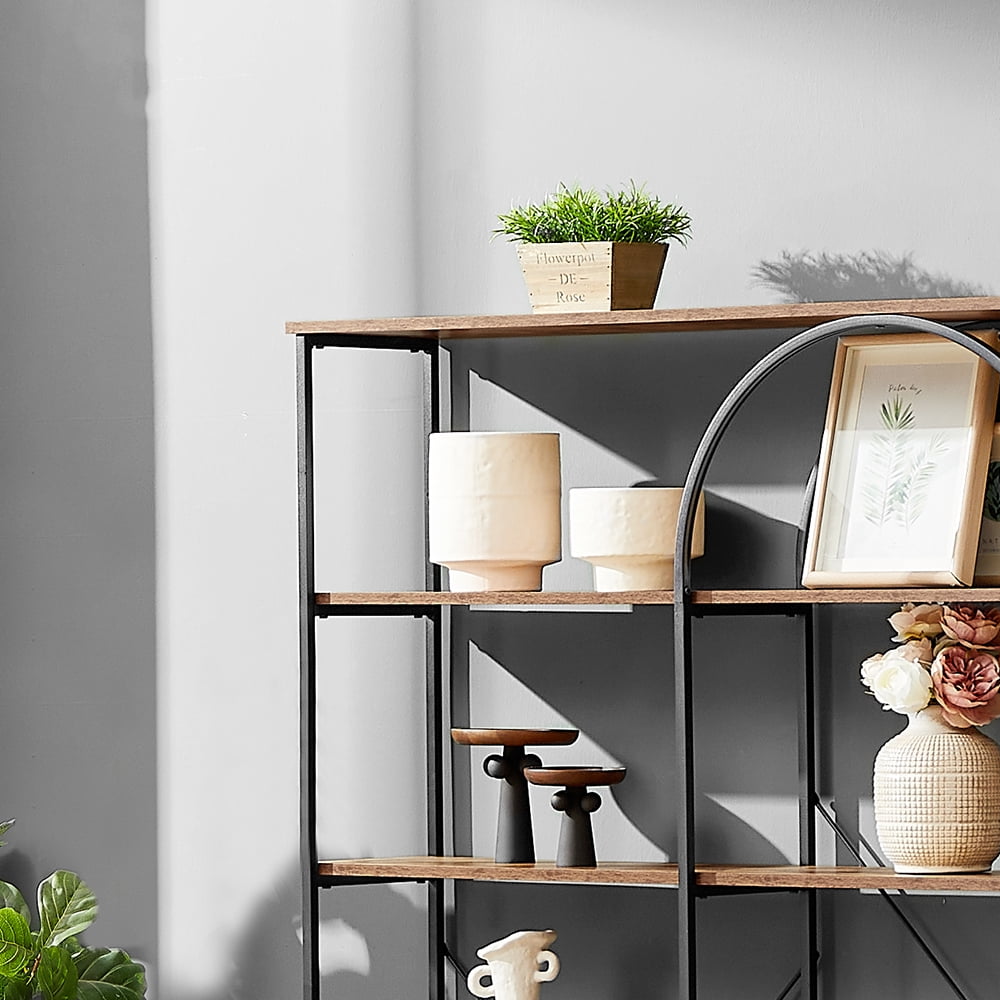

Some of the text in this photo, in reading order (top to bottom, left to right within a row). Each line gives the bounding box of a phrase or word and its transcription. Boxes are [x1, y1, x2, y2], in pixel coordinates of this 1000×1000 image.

[536, 252, 596, 266] Flowerpot
[559, 273, 577, 285] DE
[556, 291, 586, 303] Rose
